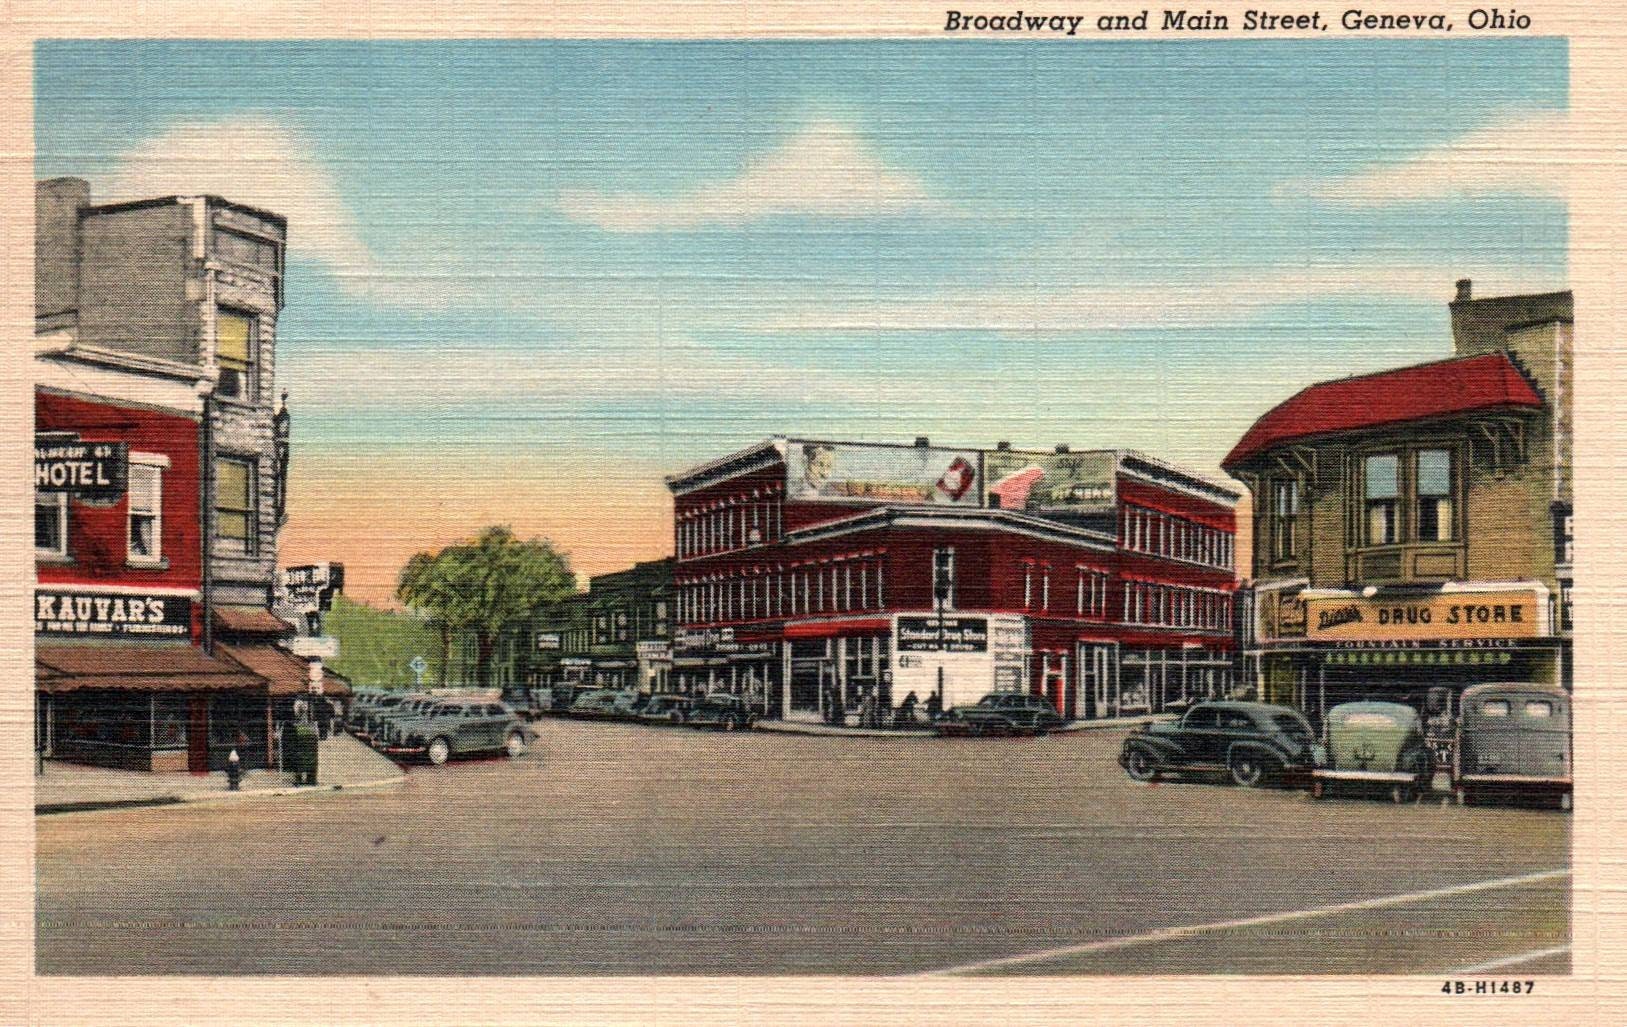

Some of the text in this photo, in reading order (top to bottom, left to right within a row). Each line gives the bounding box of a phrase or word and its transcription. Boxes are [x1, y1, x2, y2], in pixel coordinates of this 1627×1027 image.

[36, 461, 110, 486] HOTEL
[37, 595, 164, 622] KAUVAR'S
[1378, 607, 1432, 625] DRUG
[1446, 604, 1525, 624] STORE
